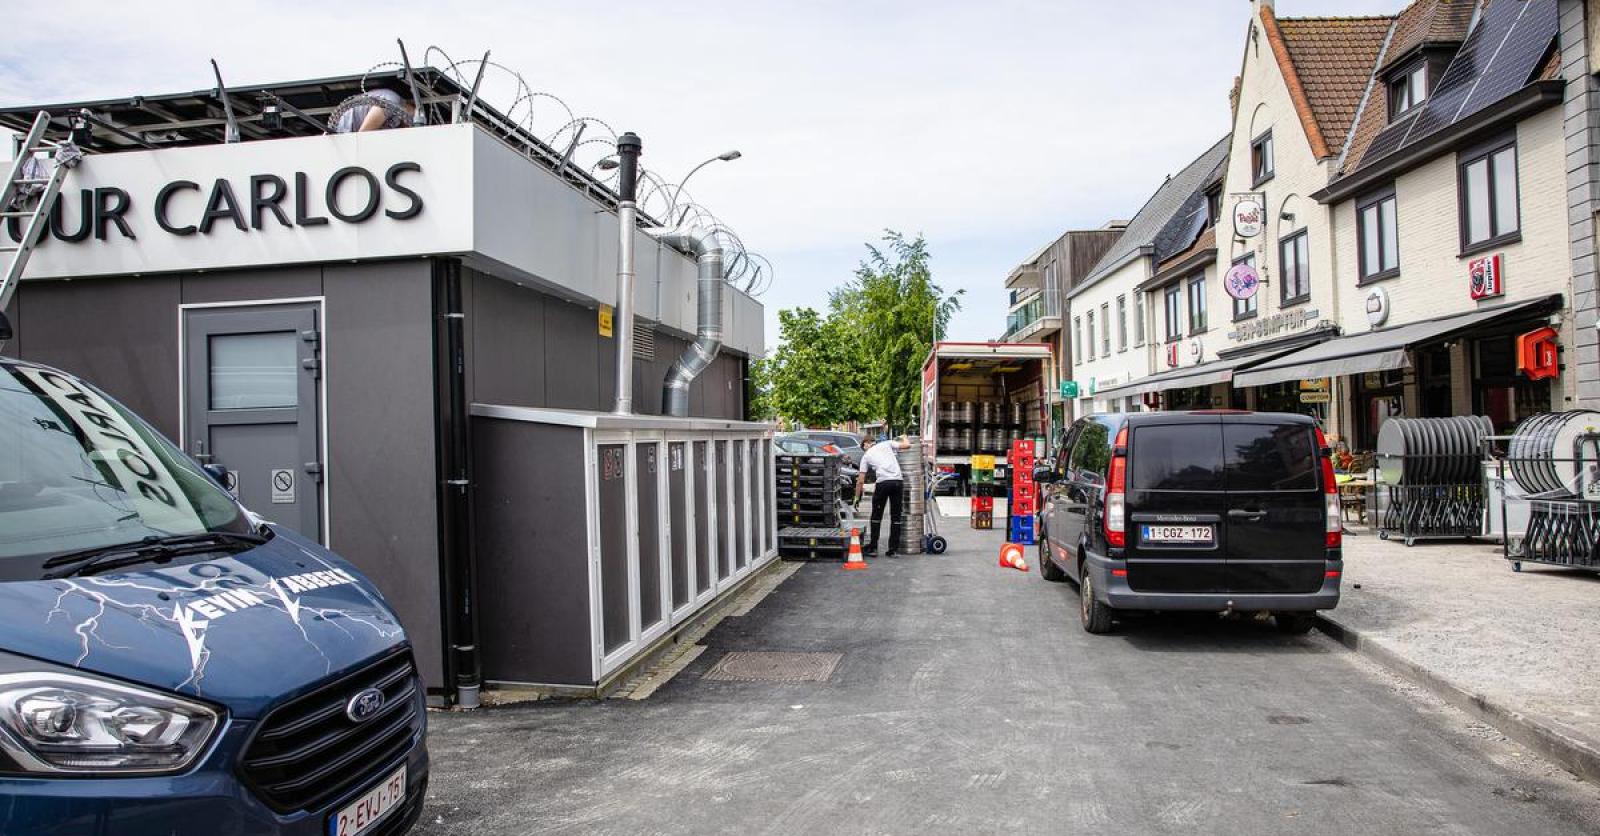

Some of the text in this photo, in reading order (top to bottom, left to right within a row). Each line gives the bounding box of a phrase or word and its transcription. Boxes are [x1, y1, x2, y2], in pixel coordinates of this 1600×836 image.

[154, 161, 425, 236] CARLOS
[1151, 528, 1210, 538] 1-CGZ-172
[173, 588, 264, 671] KEVIN
